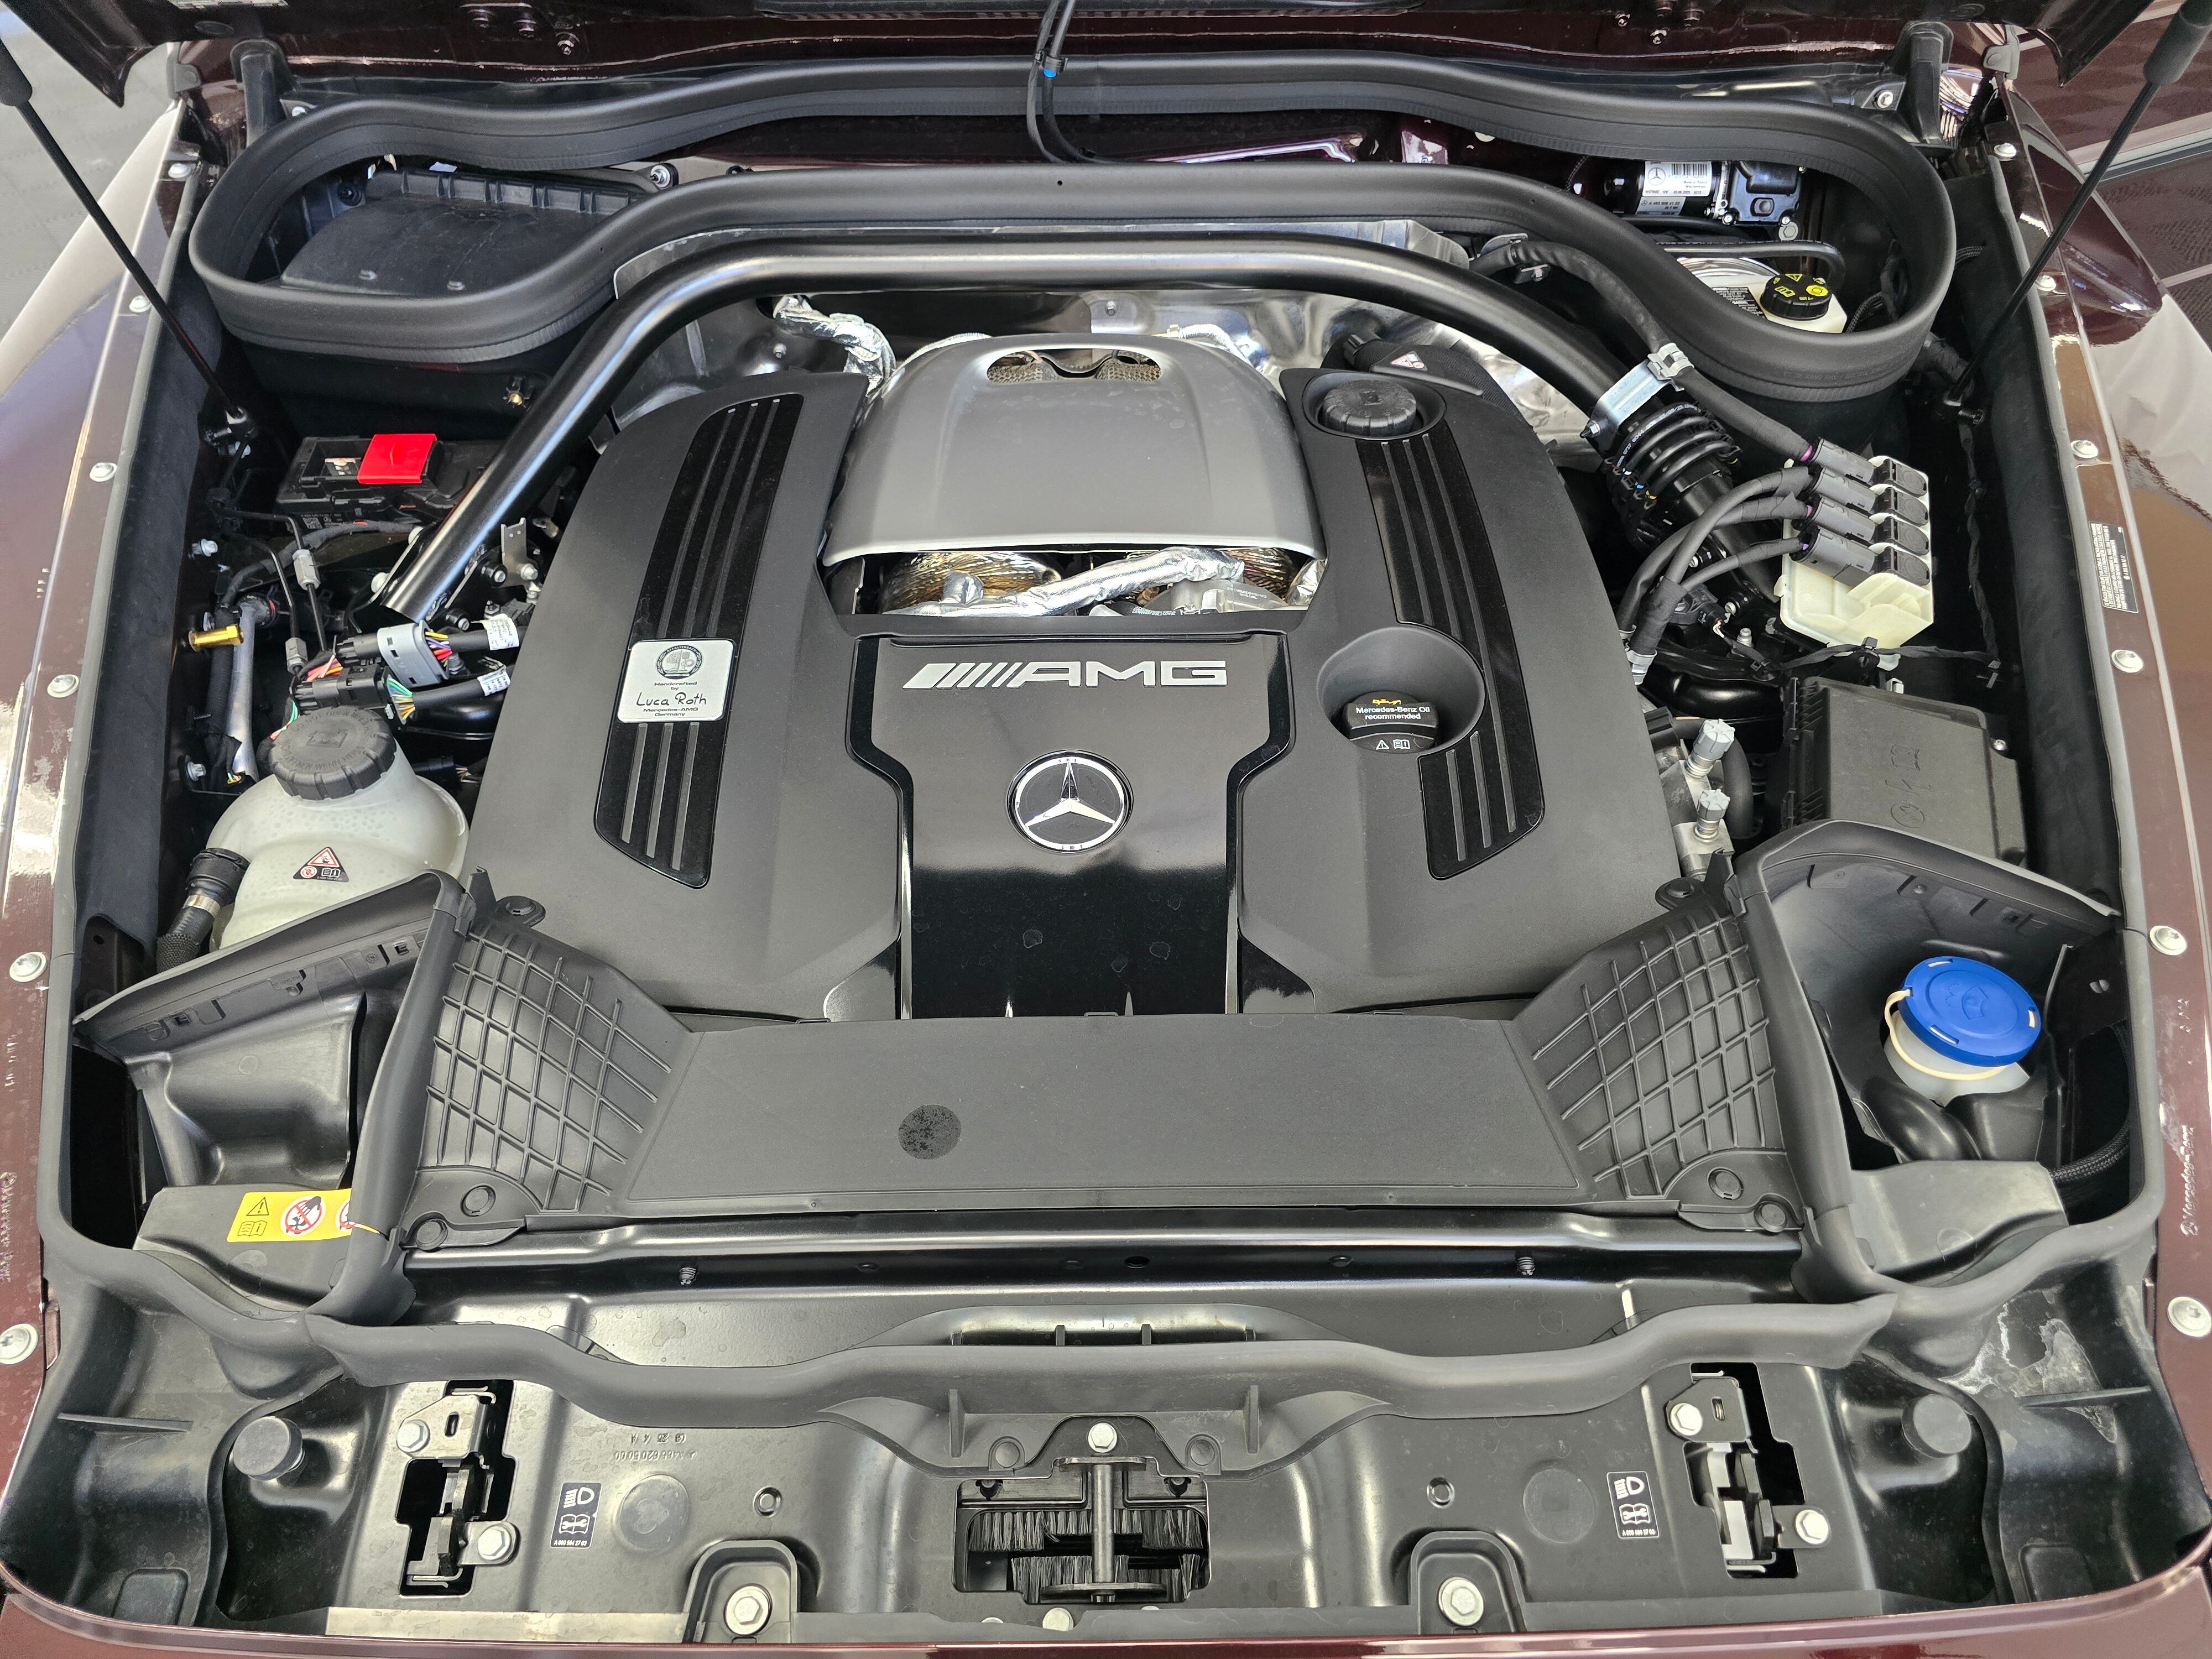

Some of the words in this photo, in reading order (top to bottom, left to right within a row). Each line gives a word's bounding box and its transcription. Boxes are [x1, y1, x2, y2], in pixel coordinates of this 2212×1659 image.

[1006, 661, 1227, 688] AMG
[636, 691, 670, 706] Luca
[675, 692, 706, 705] Roth
